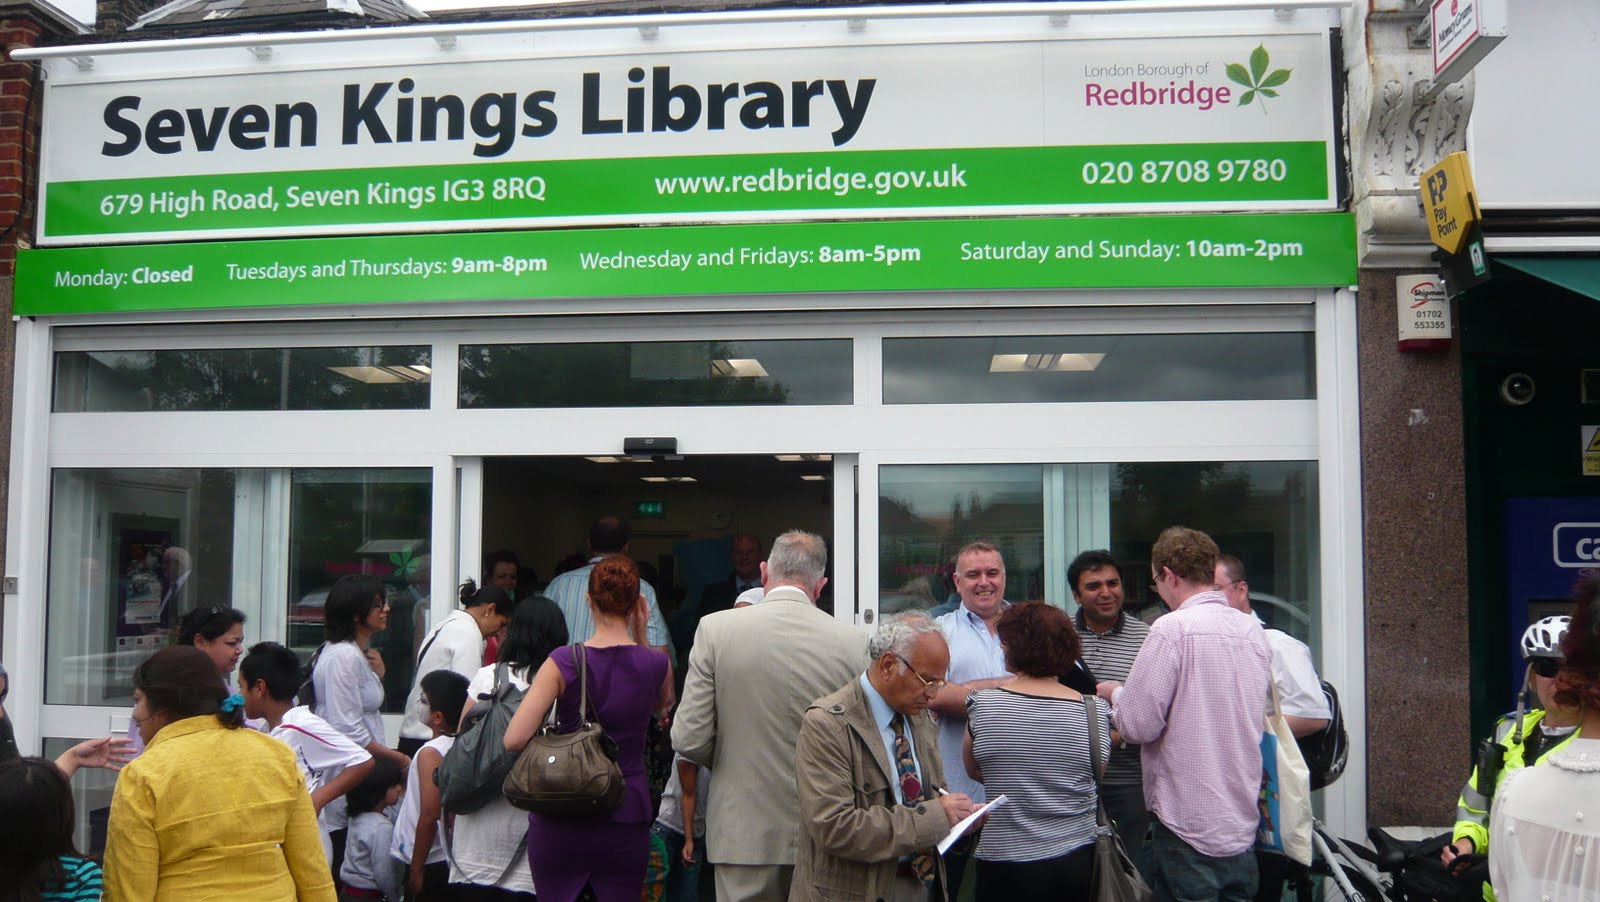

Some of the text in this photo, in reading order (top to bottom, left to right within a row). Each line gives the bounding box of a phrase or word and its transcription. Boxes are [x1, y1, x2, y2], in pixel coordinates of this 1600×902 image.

[1085, 62, 1210, 78] London Borough of
[1086, 81, 1230, 110] Redbridge
[102, 67, 876, 157] Seven Kings Library
[655, 164, 966, 195] www.redbridge.gov.uk
[1082, 159, 1286, 184] 020 8708 9780
[101, 177, 545, 218] 679 High Road, Seven Kings IG3 8RQ
[1434, 206, 1447, 222] Pay
[1437, 217, 1457, 238] Point
[580, 246, 920, 271] Wednesday and Fridays: 8am-5pm
[961, 240, 1302, 263] Saturday and Sunday: 10am-2pm
[56, 265, 193, 288] Monday: Closed
[227, 256, 547, 282] Tuesdays and Thursdays: 9am-8pm
[1414, 290, 1445, 298] Shipman
[1414, 321, 1446, 329] 553355
